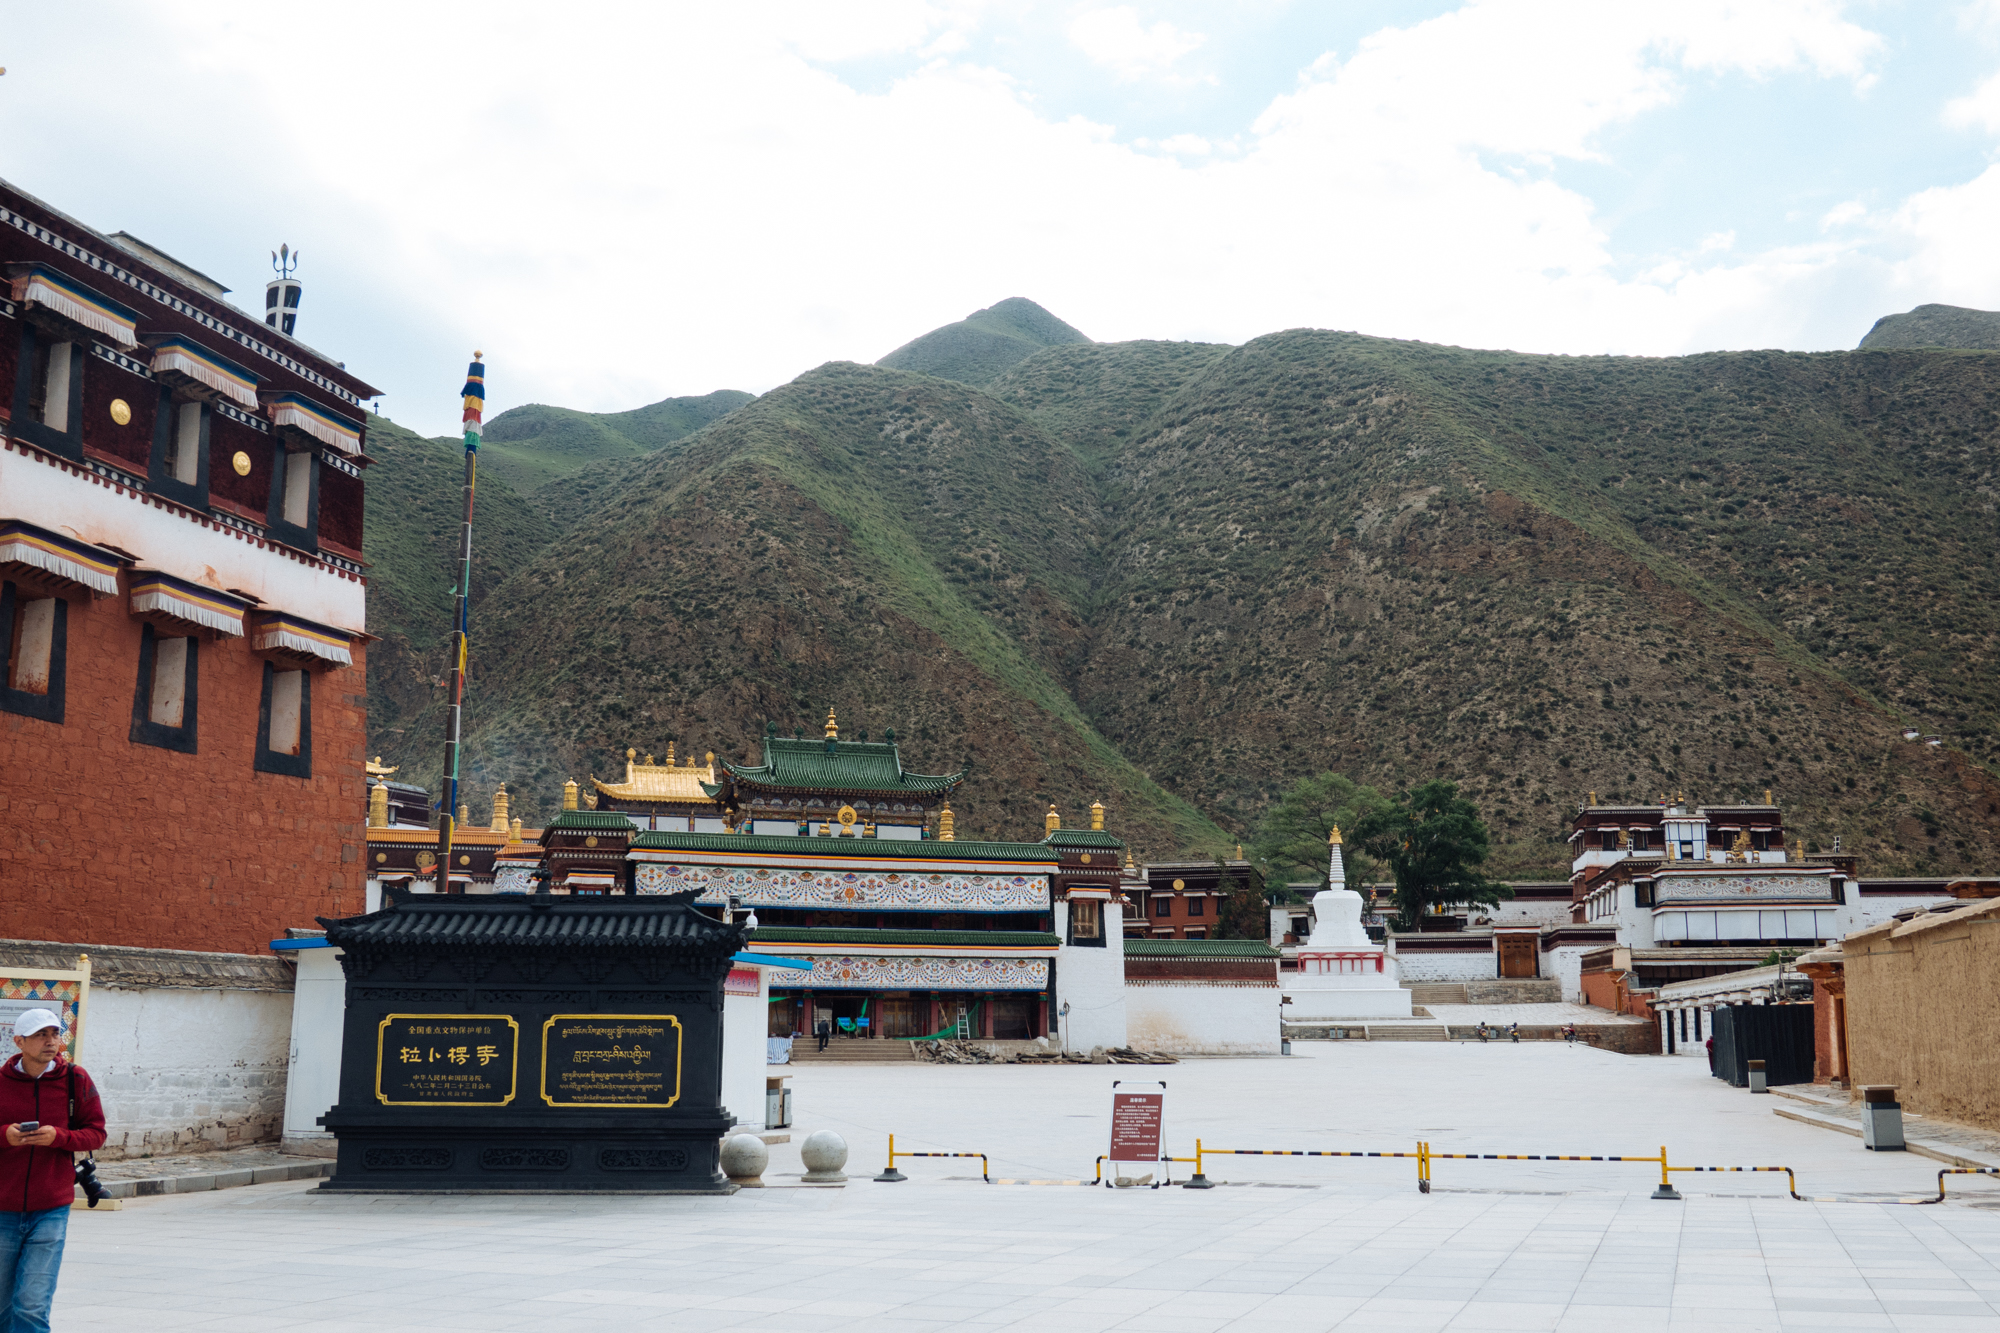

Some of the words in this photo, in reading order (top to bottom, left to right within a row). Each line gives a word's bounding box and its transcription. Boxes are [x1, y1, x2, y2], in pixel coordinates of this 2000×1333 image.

[408, 1026, 491, 1035] 全国重点文物保护单位
[400, 1045, 499, 1066] 拉卜楞寺
[412, 1074, 482, 1082] 中华人民共和国国务院
